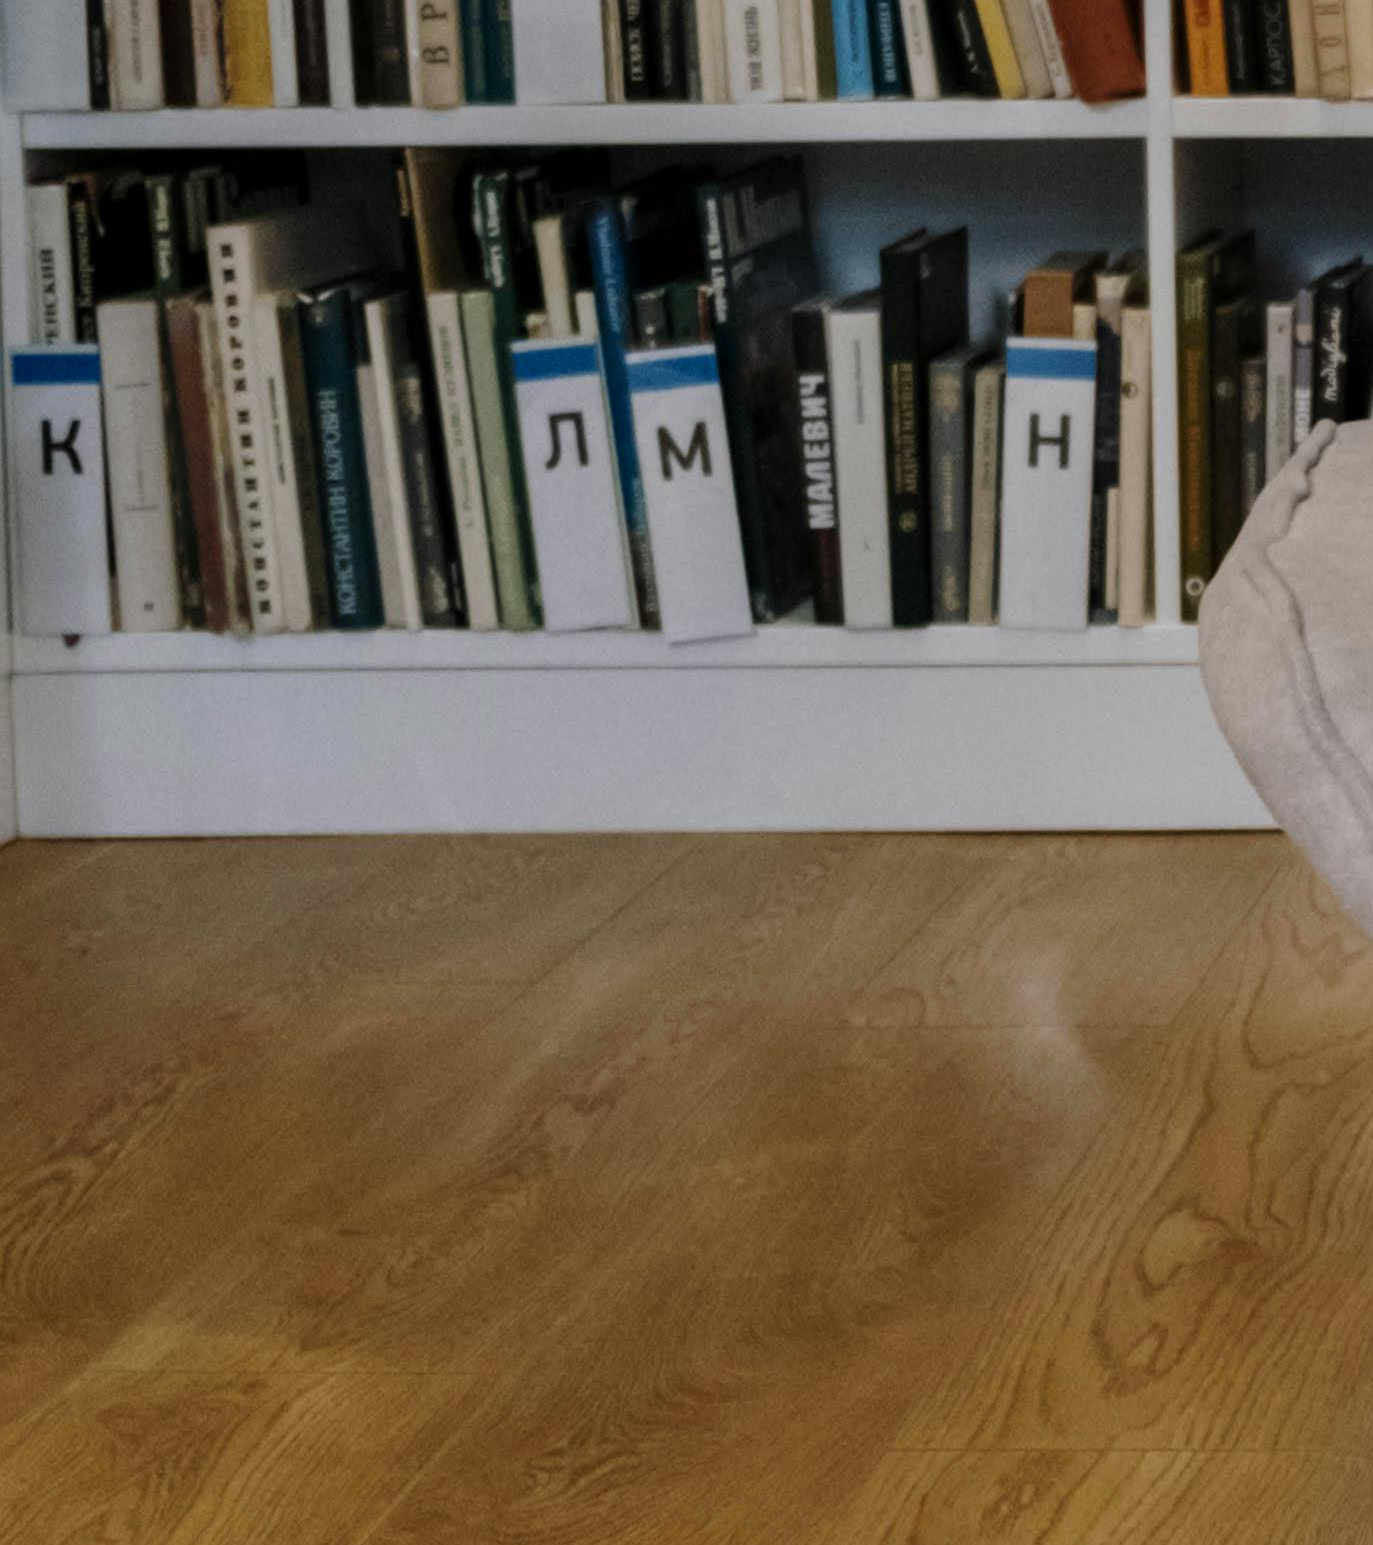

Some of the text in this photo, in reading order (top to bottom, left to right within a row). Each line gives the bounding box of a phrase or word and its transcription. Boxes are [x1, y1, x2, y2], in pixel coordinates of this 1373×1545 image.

[221, 242, 253, 392] КОРОВИН
[43, 418, 85, 477] К
[321, 387, 349, 492] КОРОВИН
[547, 412, 593, 469] Л
[660, 424, 716, 484] М
[798, 374, 840, 534] МАЛЕВИЧ
[1031, 413, 1074, 470] Н
